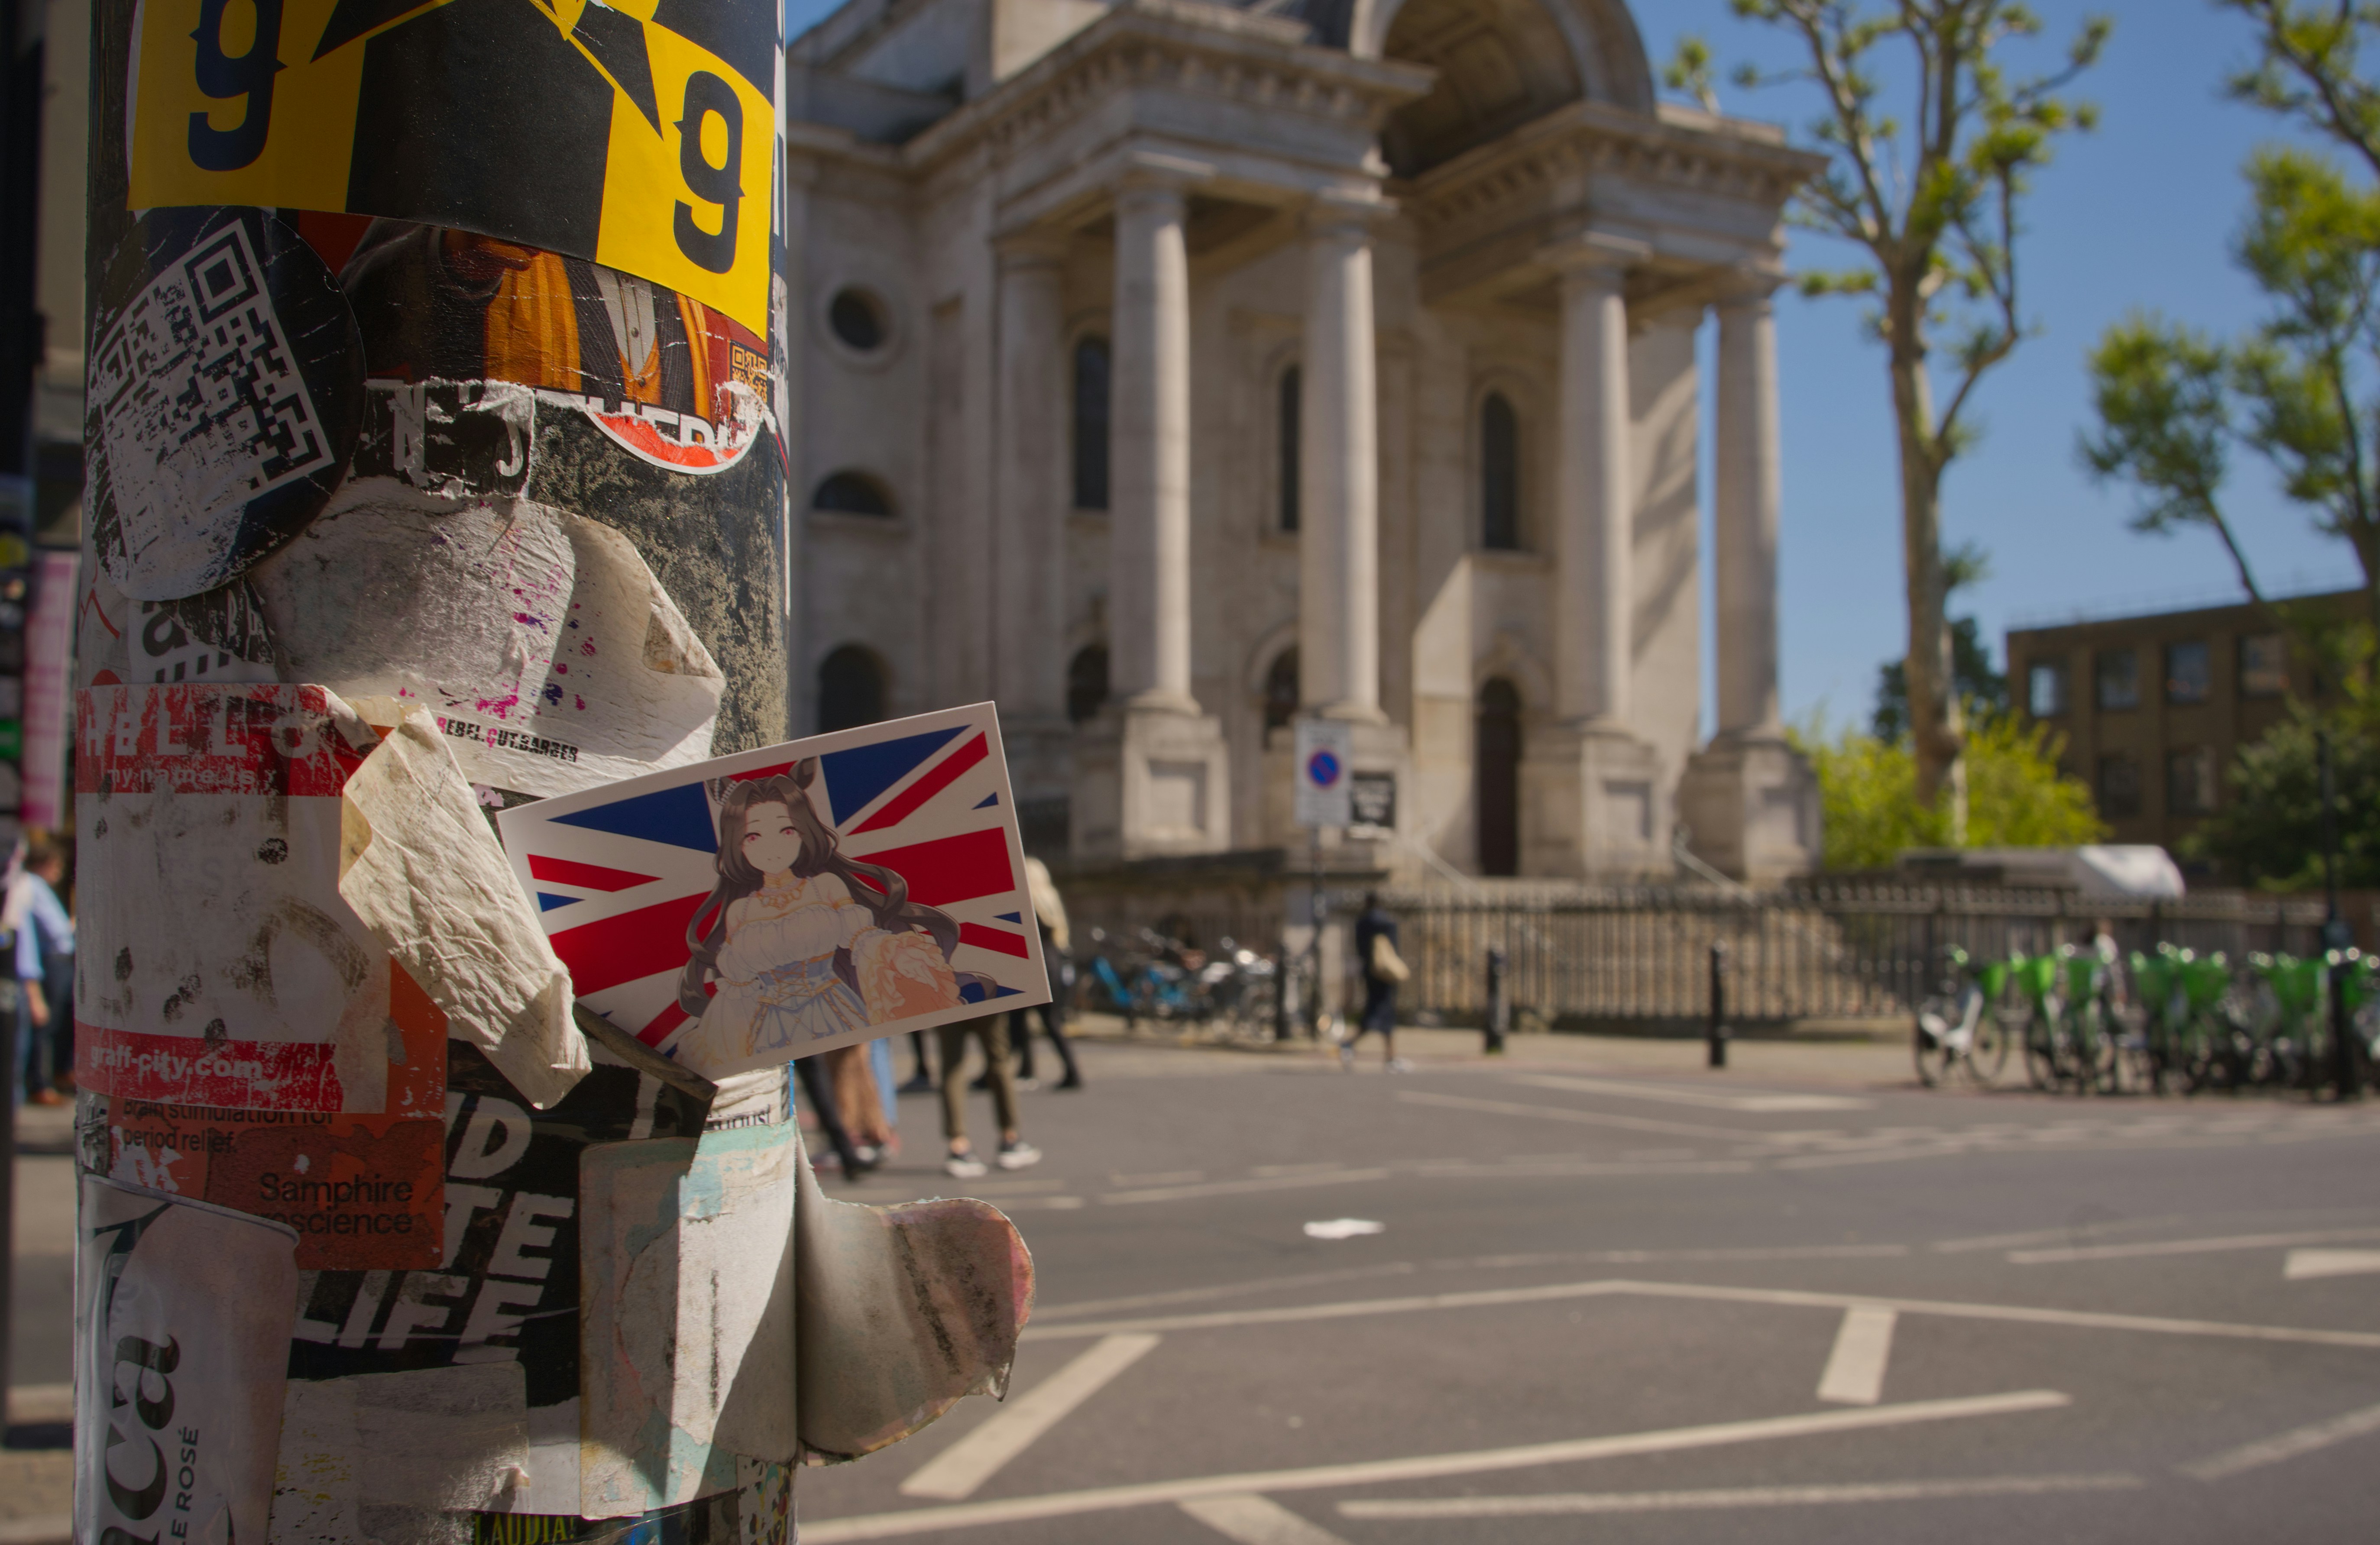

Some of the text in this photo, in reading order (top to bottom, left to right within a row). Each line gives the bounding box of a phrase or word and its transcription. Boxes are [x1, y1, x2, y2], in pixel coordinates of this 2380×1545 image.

[91, 1044, 263, 1080] graff-city.com
[123, 1127, 176, 1151] period
[260, 1172, 412, 1209] Samphire
[291, 1270, 546, 1365] LIFE
[175, 1426, 199, 1512] ROSÉ
